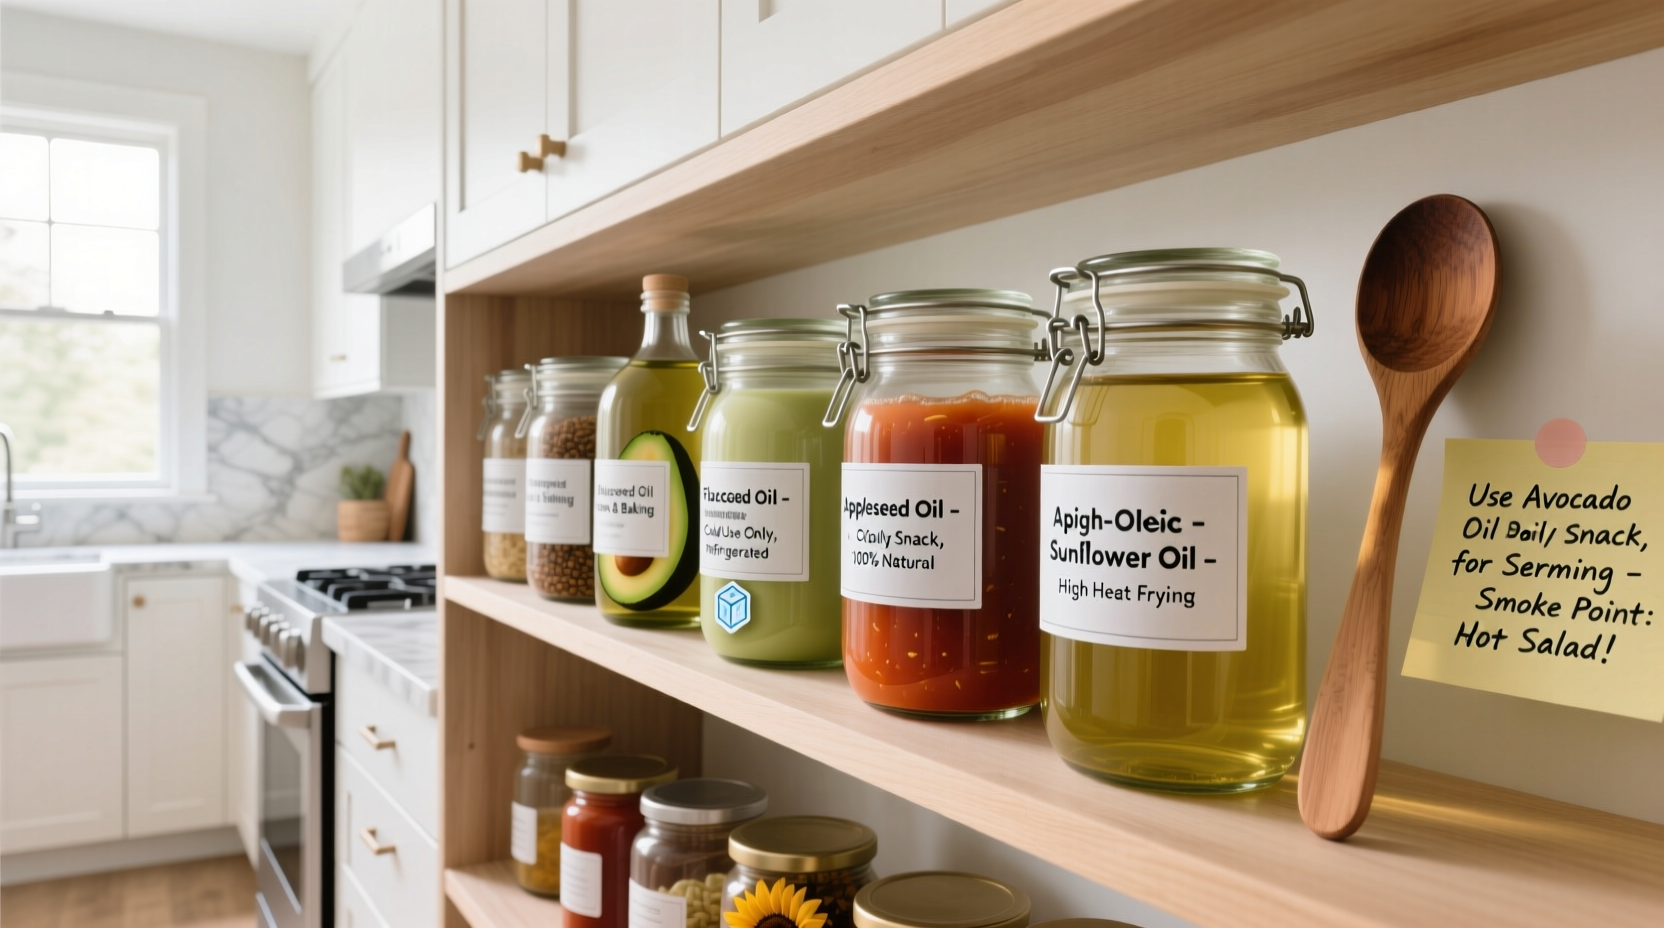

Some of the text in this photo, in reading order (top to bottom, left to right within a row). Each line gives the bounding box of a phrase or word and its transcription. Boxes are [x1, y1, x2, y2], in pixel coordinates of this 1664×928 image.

[755, 488, 777, 505] Oil
[844, 496, 910, 520] Appleseed
[915, 499, 944, 518] Oil
[1469, 482, 1632, 511] Use Avocado
[744, 526, 777, 544] Only,
[1053, 506, 1182, 536] Apigh-Oleic
[1462, 516, 1500, 540] Oil
[1564, 523, 1648, 552] Snack,
[894, 530, 944, 550] Snack,
[1050, 539, 1151, 569] Sunflower
[1158, 545, 1196, 570] Oil
[852, 551, 935, 570] 100% Natural
[1451, 549, 1493, 576] for
[1501, 553, 1614, 595] Serming
[1058, 578, 1196, 609] High Heat Frying
[1474, 587, 1654, 626] Smoke Point:
[1453, 621, 1616, 665] Hot Salad!
